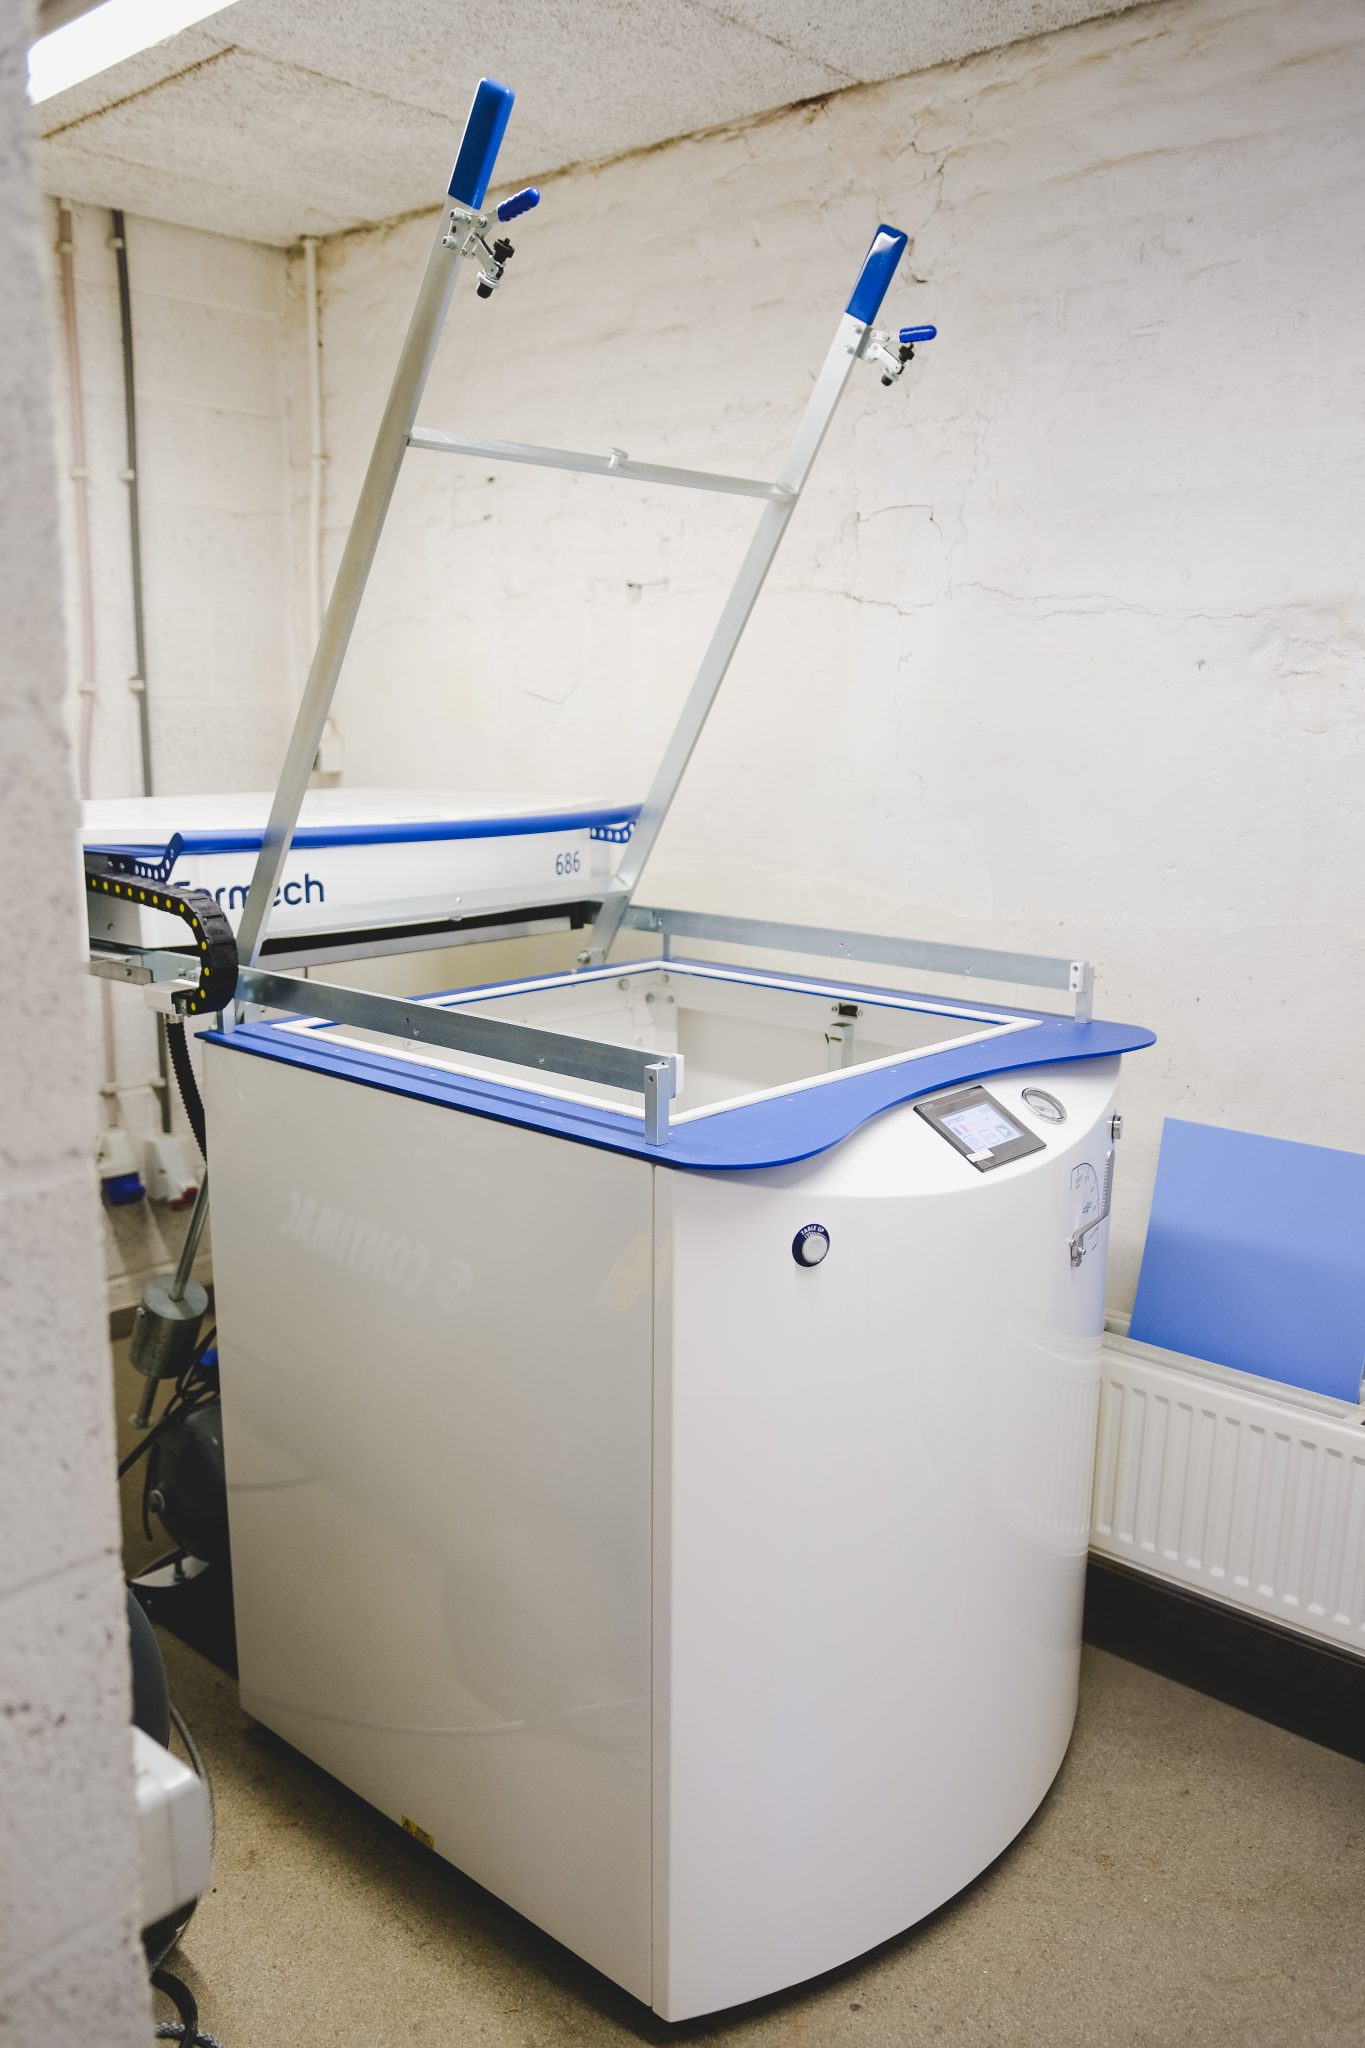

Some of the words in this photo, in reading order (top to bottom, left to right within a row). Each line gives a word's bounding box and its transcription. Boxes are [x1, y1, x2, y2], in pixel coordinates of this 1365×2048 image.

[556, 852, 580, 875] 686
[174, 873, 325, 910] rmch
[800, 1225, 817, 1236] TABLE
